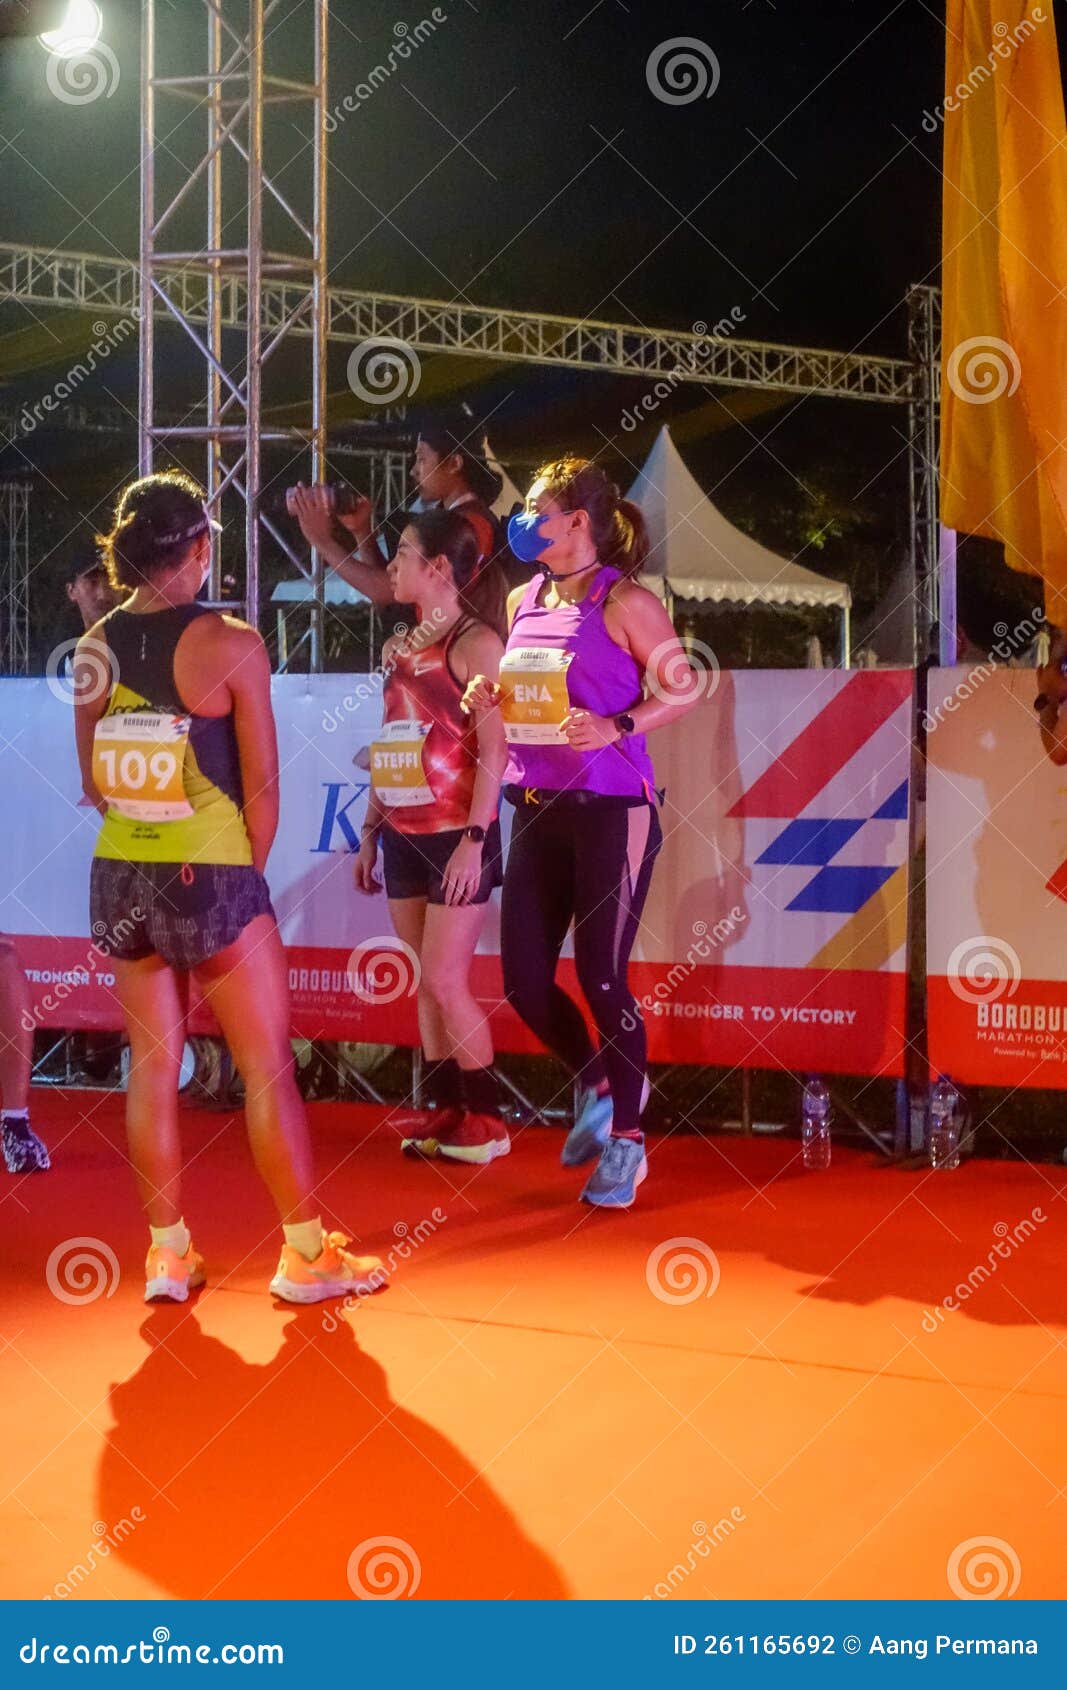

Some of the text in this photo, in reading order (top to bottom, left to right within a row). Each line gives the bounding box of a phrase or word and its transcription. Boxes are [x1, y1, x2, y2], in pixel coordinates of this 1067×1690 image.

[514, 683, 553, 703] ENA
[99, 749, 177, 791] 109
[374, 751, 419, 769] STEFFI
[24, 969, 116, 987] TRONGER TO
[288, 967, 375, 994] OROBUDUR
[653, 1000, 857, 1025] STRONGER TO VICTORY
[977, 1030, 1055, 1045] MARATHON
